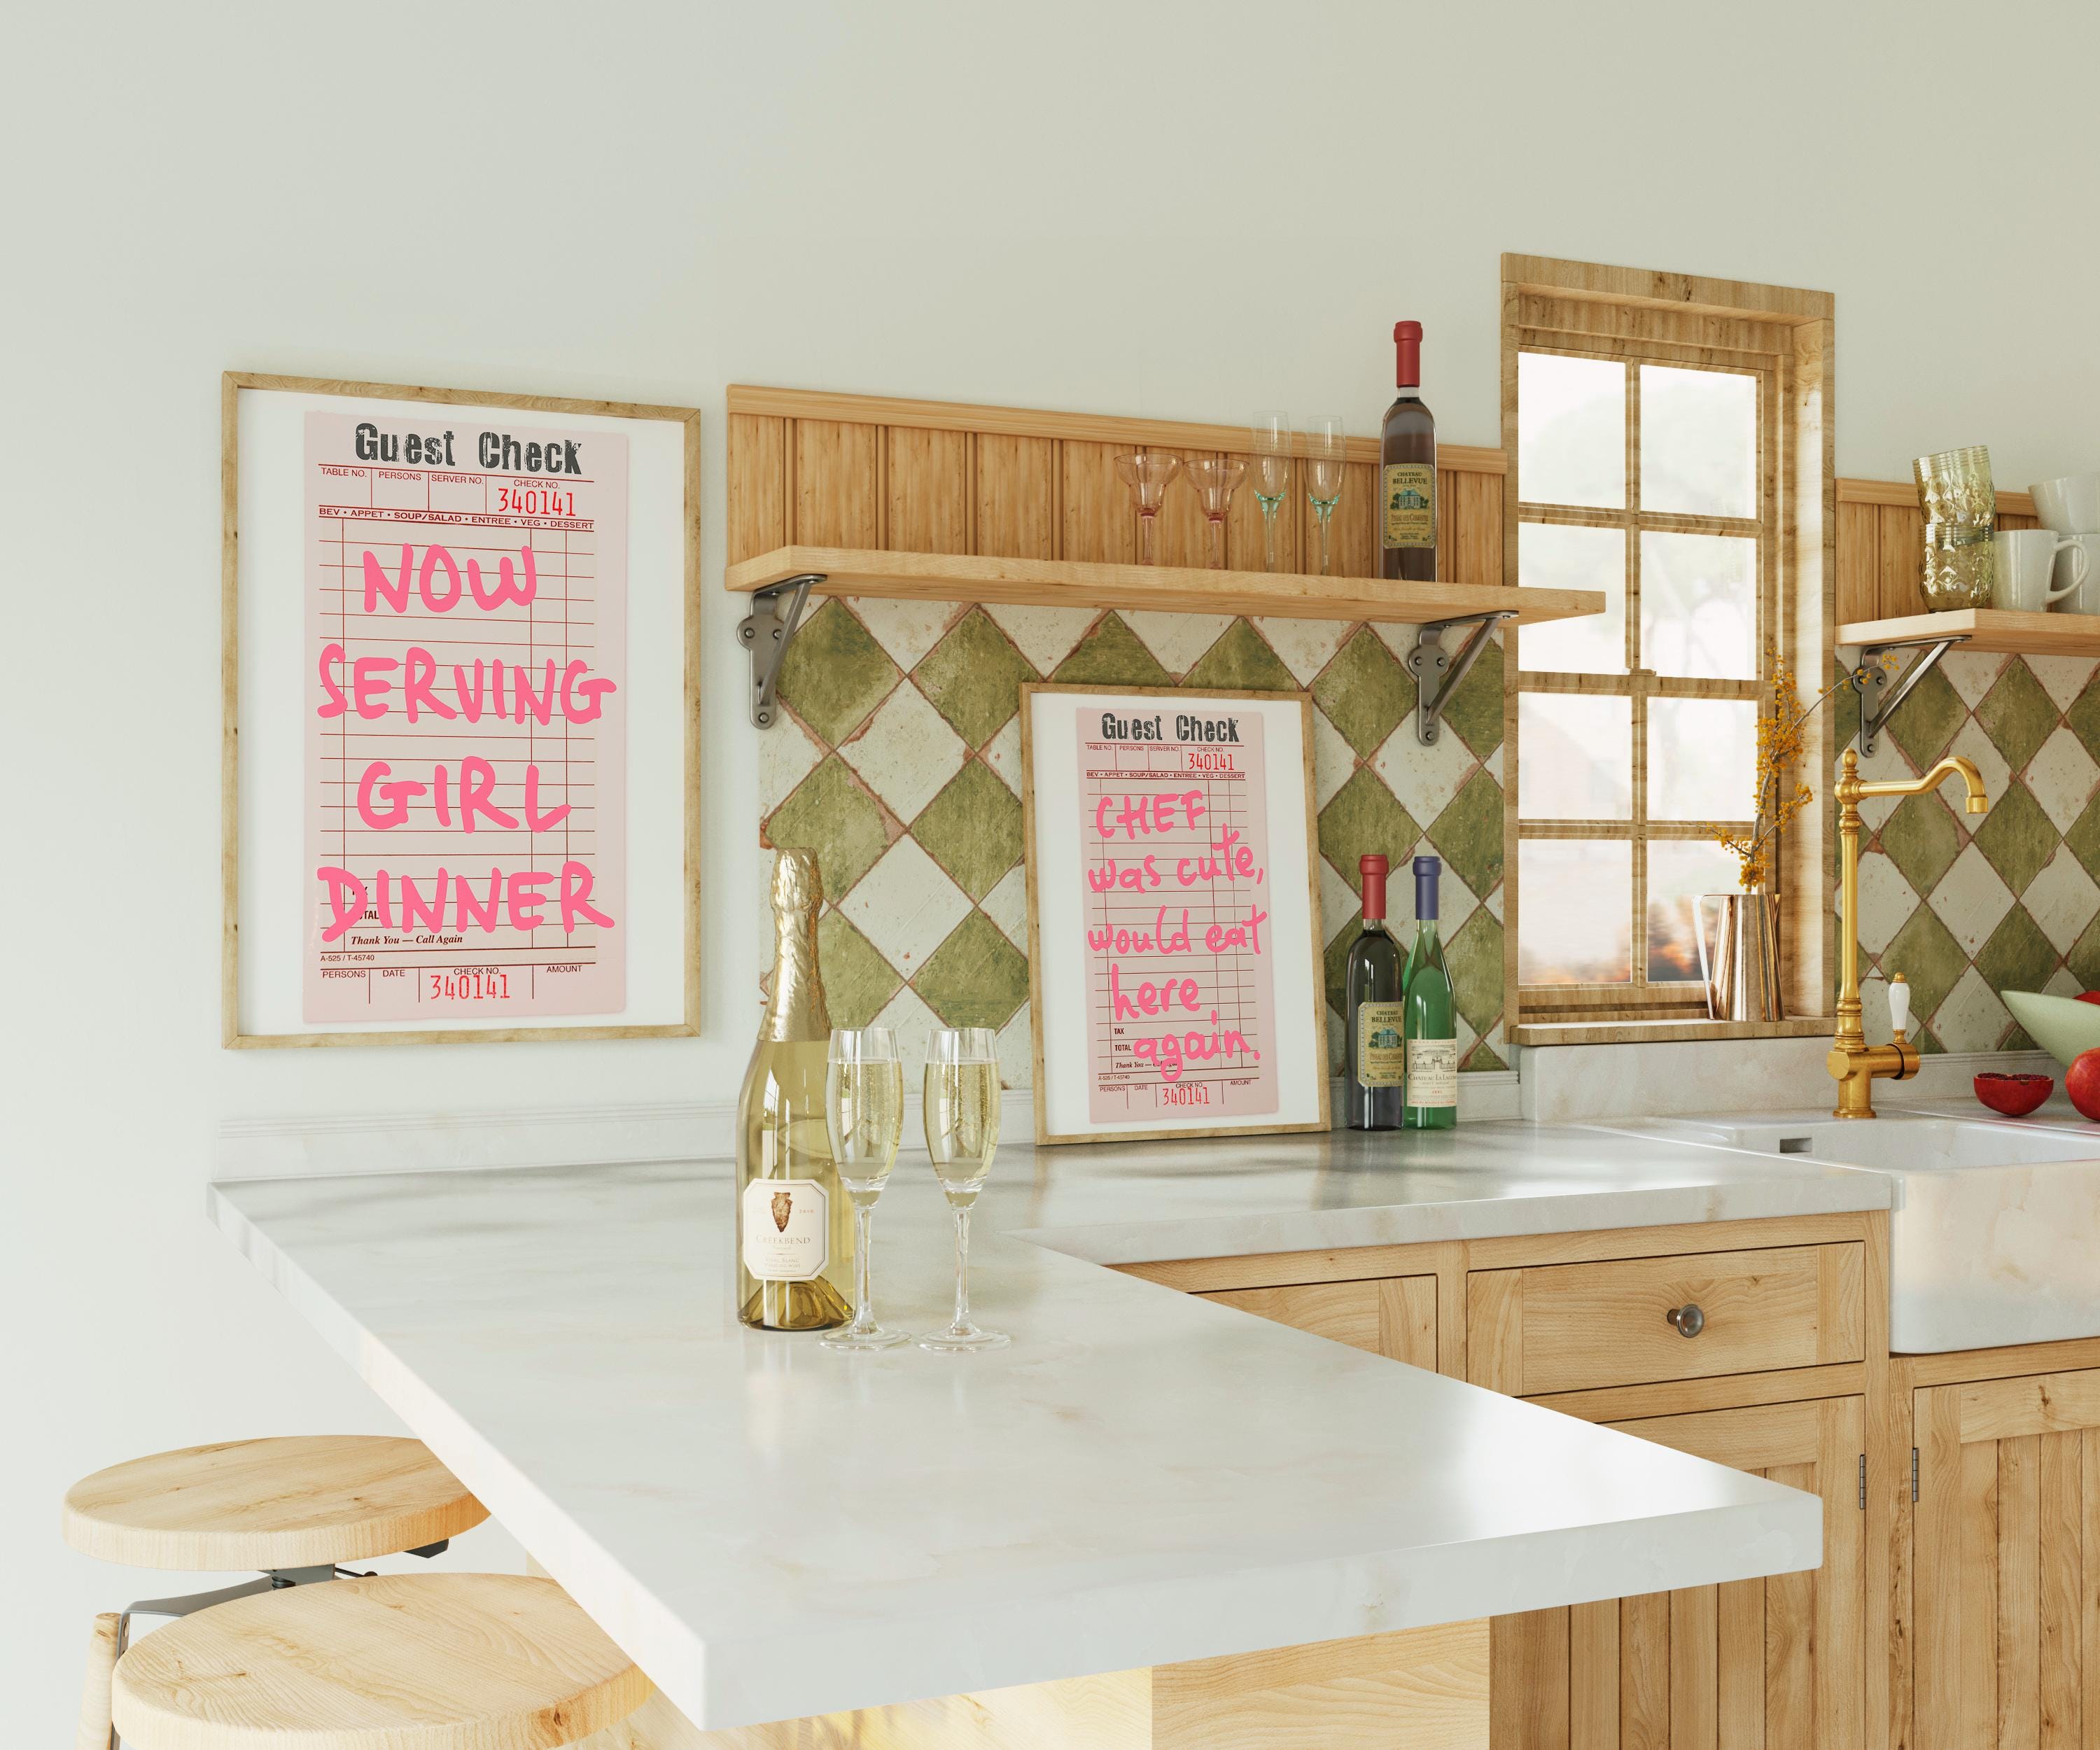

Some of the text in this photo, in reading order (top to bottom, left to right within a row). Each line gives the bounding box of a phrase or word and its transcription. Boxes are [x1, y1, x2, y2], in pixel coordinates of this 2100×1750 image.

[355, 422, 582, 475] Guest Check
[321, 467, 368, 478] TABLE NO.
[378, 470, 421, 482] PERSONS
[430, 474, 484, 485] SERVER NO.
[513, 479, 561, 489] CHECK NO.
[498, 487, 577, 517] 340141
[318, 507, 594, 530] BEV APPET SOUP/SALAD ENTREE VEG DESSERT
[363, 542, 537, 613] NOW
[317, 643, 617, 726] SERVING
[1101, 713, 1240, 743] Guest Check
[1188, 752, 1235, 771] 340141
[357, 755, 572, 834] GIRL
[1096, 790, 1205, 840] CHEF
[1088, 823, 1264, 894] was cute,
[316, 860, 615, 942] DINNER
[351, 935, 381, 946] Thank
[382, 935, 400, 946] You
[416, 934, 434, 944] Call
[435, 934, 463, 945] Again
[1087, 904, 1268, 955] would eat
[322, 969, 367, 979] PERSONS
[382, 969, 405, 978] DATE
[454, 967, 501, 976] CHECK NO.
[546, 964, 583, 973] AMOUNT
[430, 974, 511, 1000] 340141
[1110, 963, 1201, 1021] here
[1133, 1009, 1261, 1083] again.
[1163, 1086, 1210, 1106] 340141
